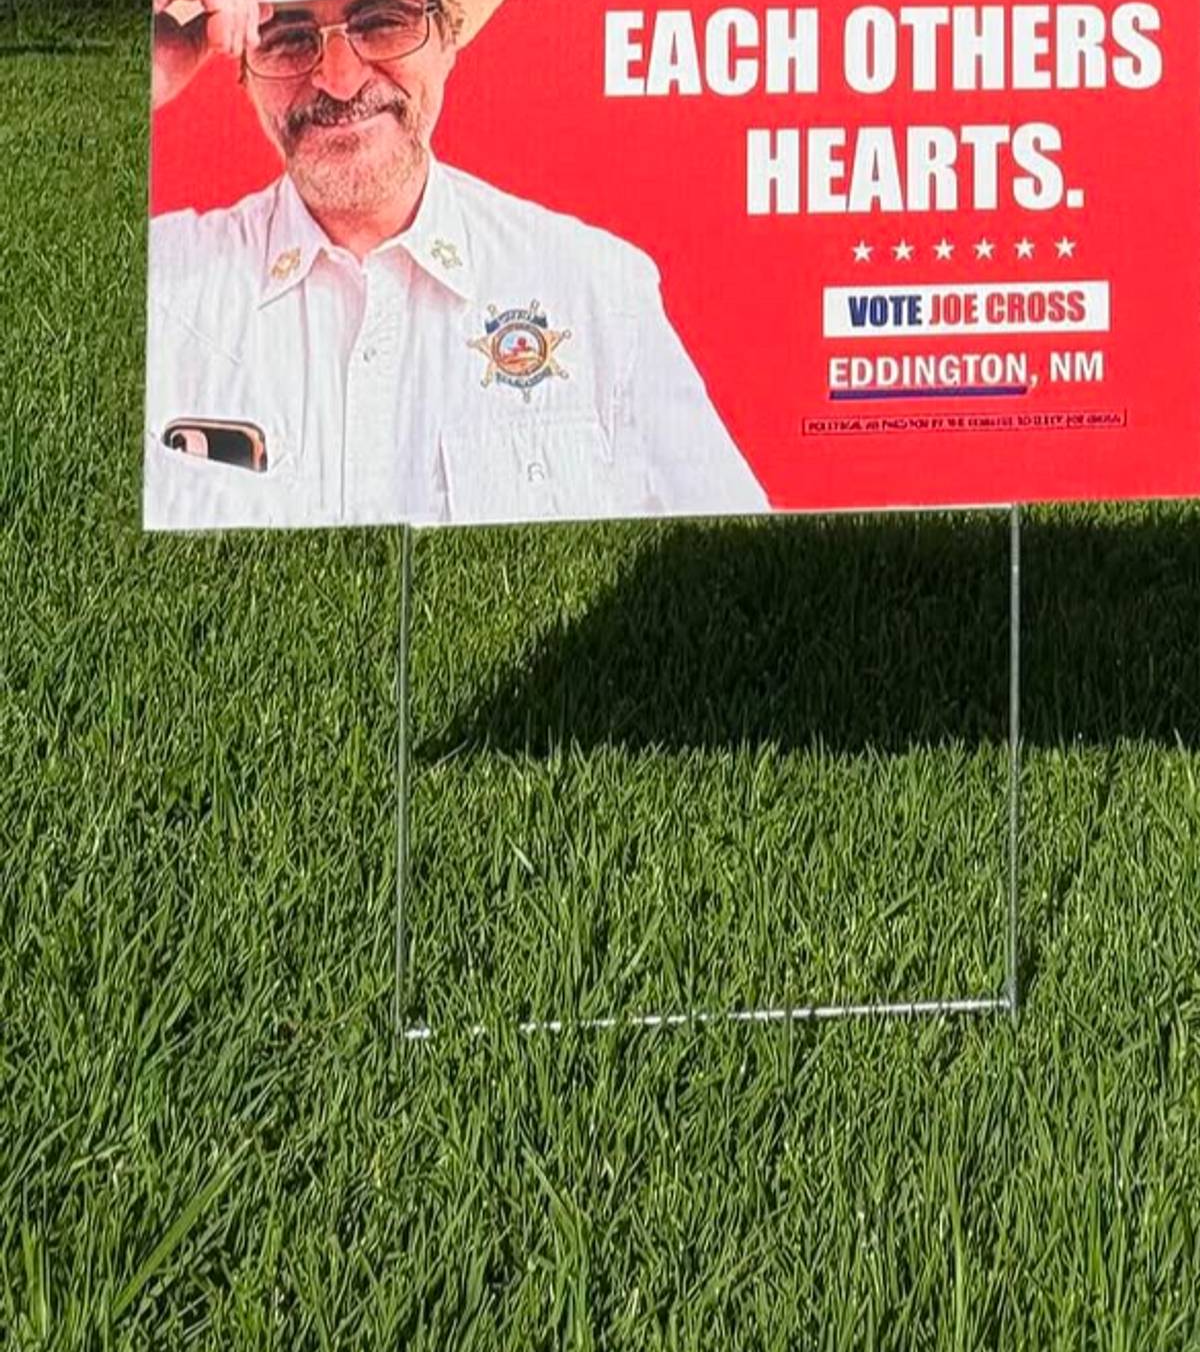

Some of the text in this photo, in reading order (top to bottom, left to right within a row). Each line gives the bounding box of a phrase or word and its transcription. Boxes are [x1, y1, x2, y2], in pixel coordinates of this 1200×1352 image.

[603, 2, 1163, 97] EACH OTHERS
[746, 122, 1084, 215] HEARTS.
[848, 291, 1086, 328] VOTE JOE CROSS
[828, 350, 1104, 389] EDDINGTON, NM
